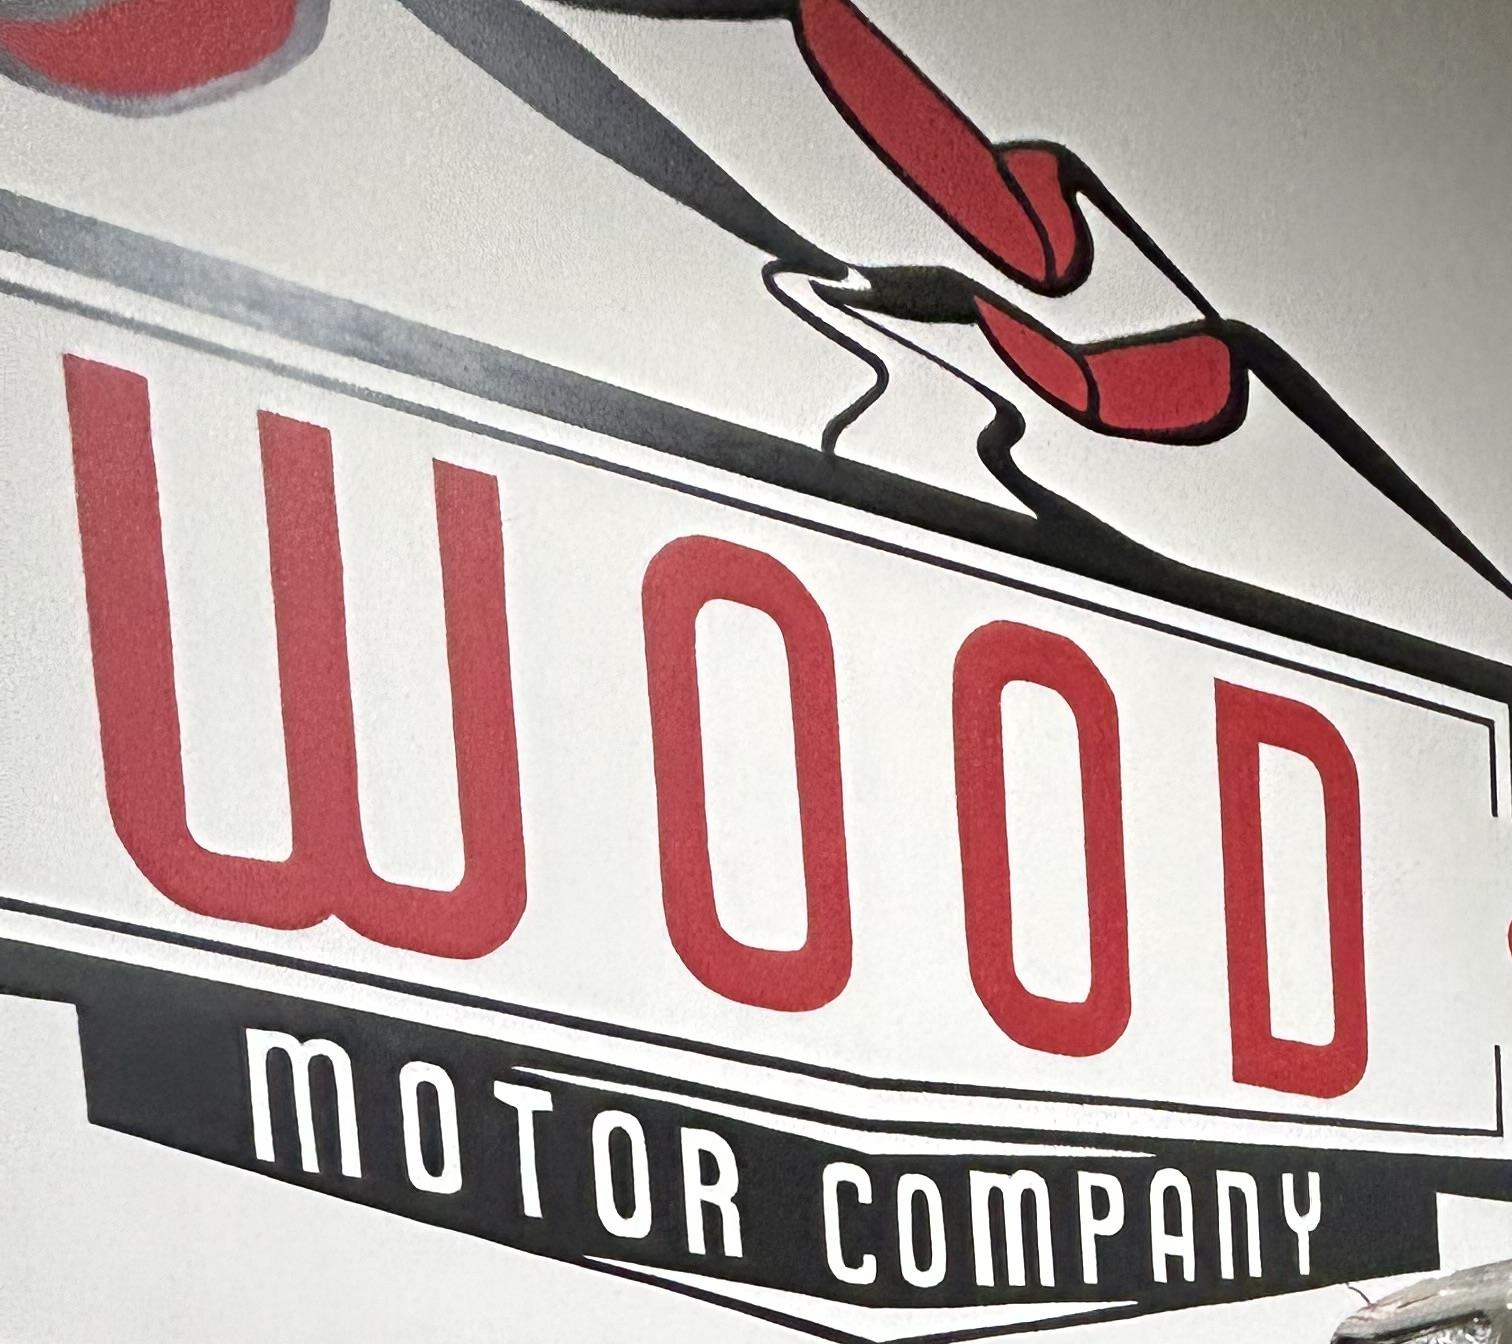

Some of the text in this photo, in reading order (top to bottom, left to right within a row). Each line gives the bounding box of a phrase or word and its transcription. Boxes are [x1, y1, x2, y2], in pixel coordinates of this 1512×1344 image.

[63, 353, 1369, 1099] WOOD
[245, 1027, 1323, 1289] MOTOR COMPANY
